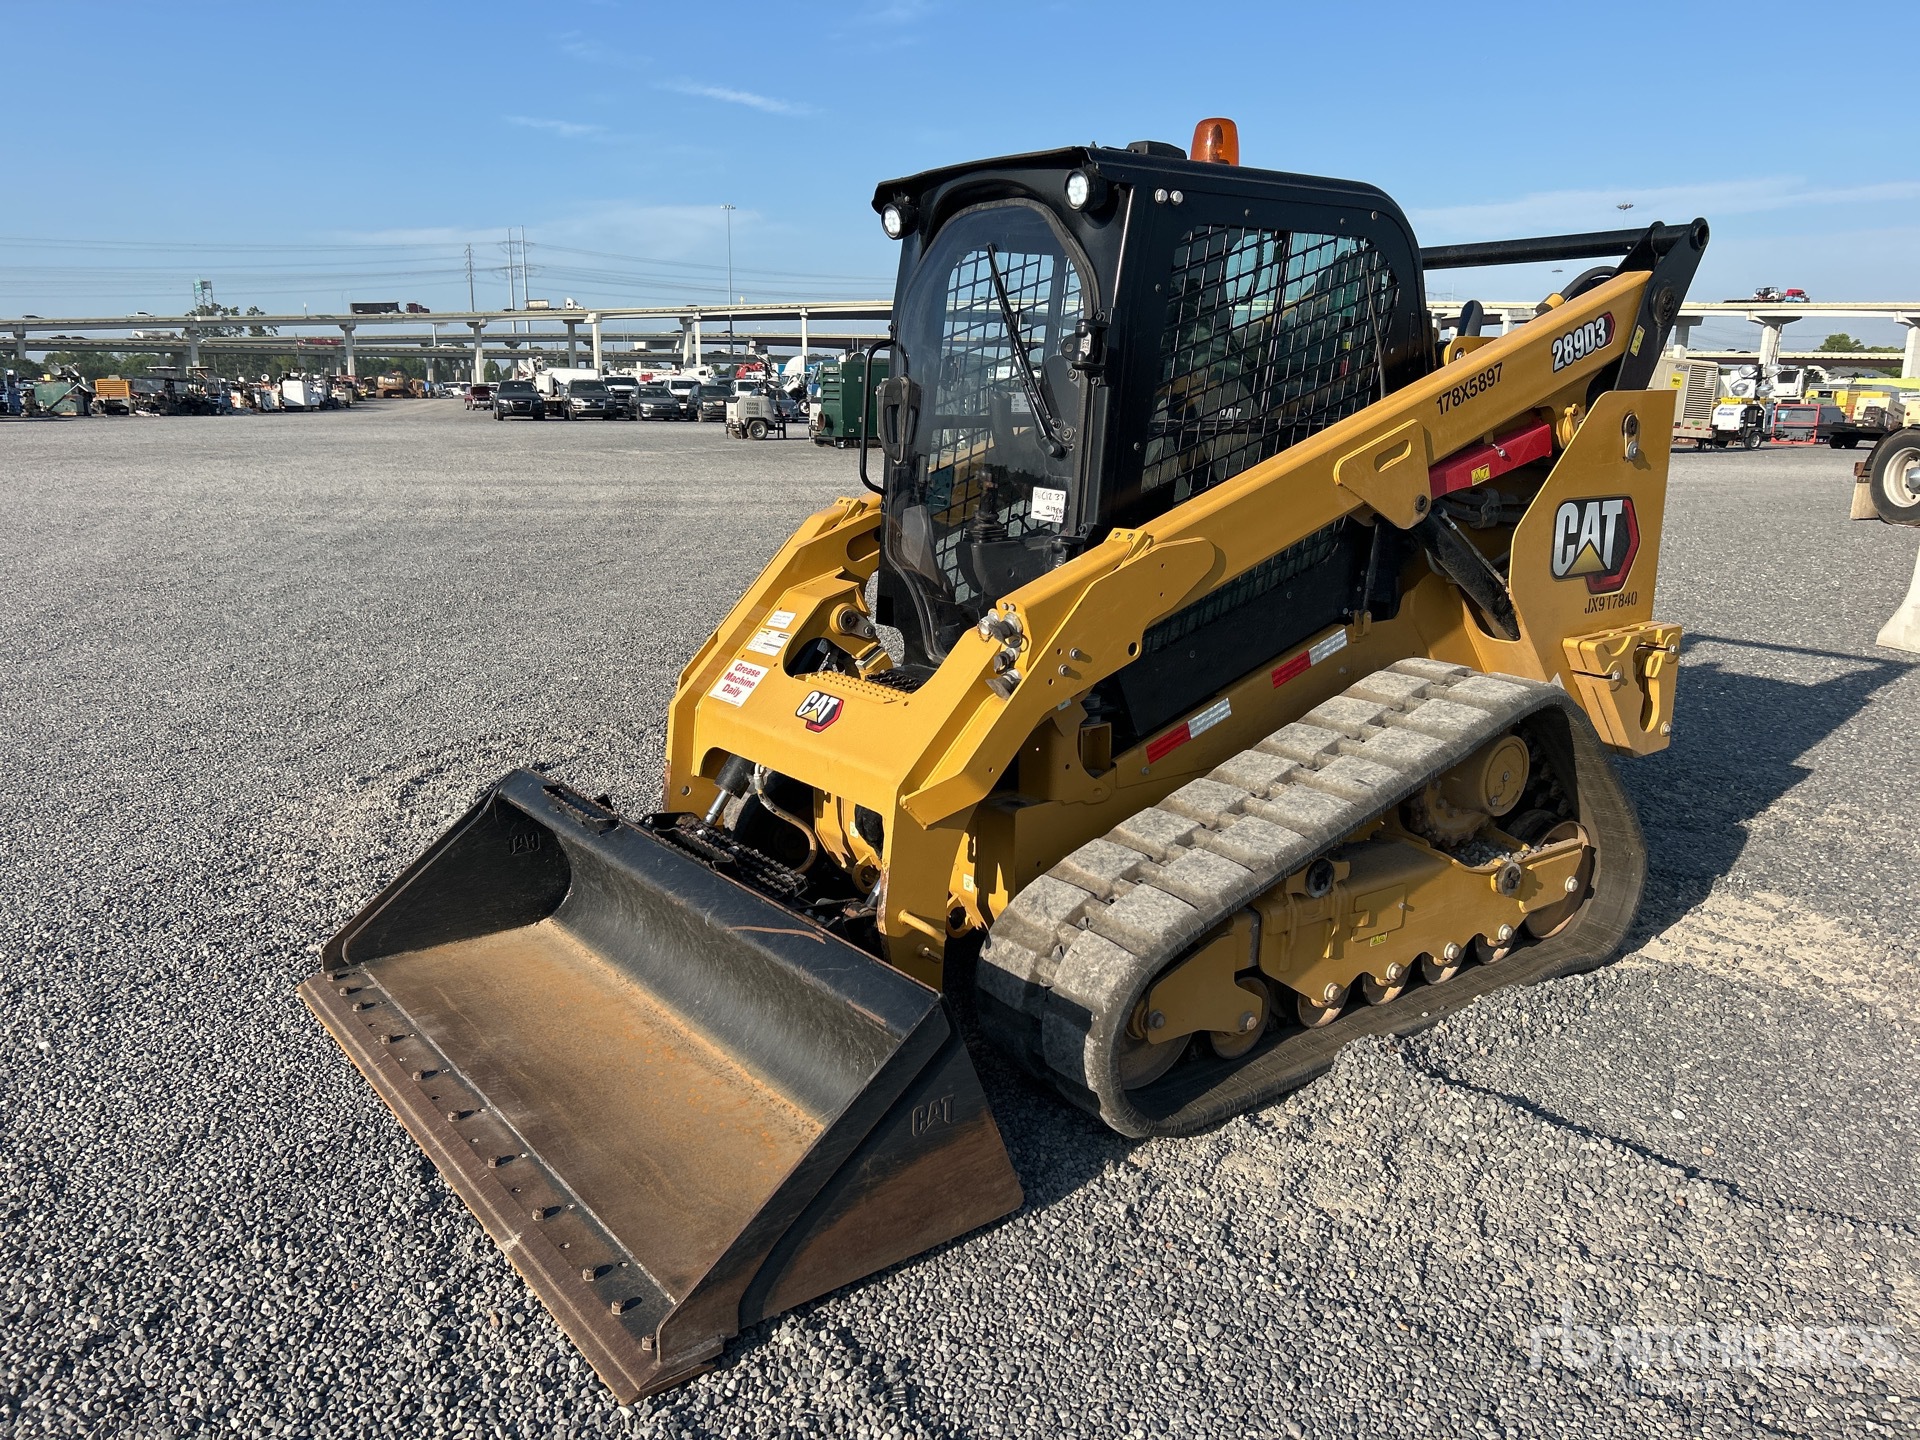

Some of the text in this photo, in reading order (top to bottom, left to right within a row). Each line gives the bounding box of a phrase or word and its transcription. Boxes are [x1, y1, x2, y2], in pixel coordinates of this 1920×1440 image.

[1552, 317, 1607, 371] 289D3
[1436, 361, 1503, 415] 178X5897
[1218, 408, 1242, 420] CAT
[1553, 499, 1624, 577] CAT
[1584, 591, 1638, 614] JX917840
[724, 672, 756, 689] Machine
[734, 663, 761, 678] Grease
[722, 684, 743, 698] Daily
[796, 691, 840, 724] CAT
[911, 1093, 955, 1137] CAT
